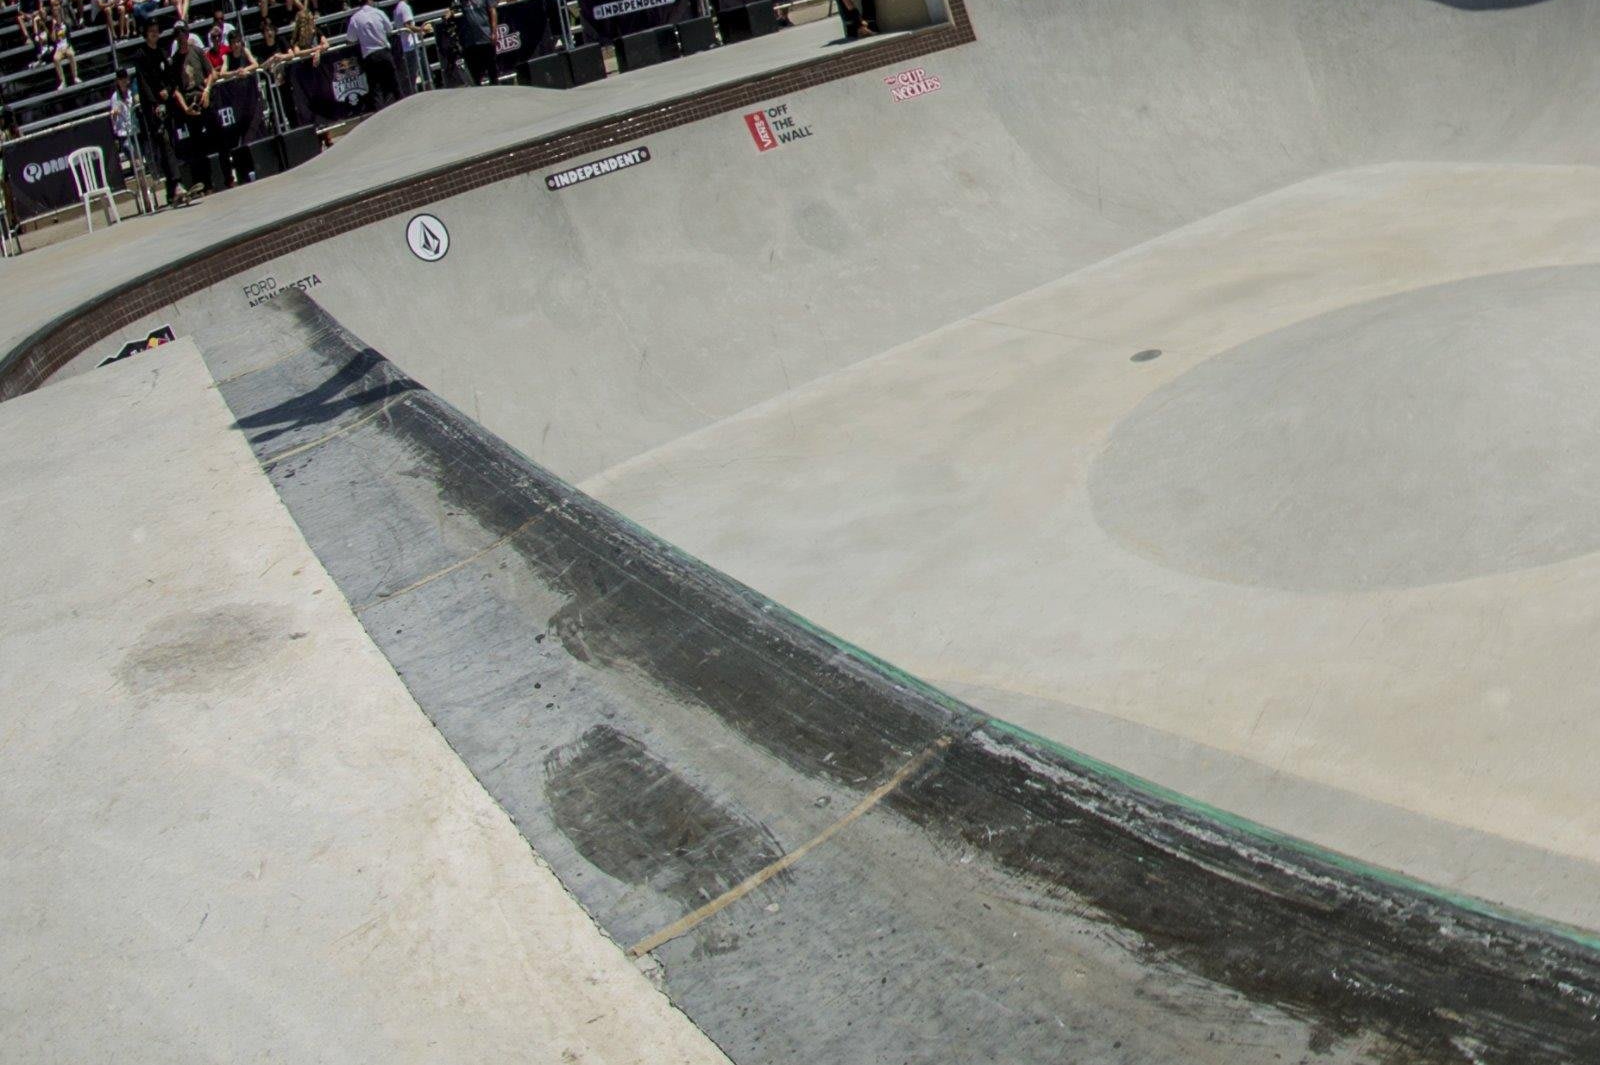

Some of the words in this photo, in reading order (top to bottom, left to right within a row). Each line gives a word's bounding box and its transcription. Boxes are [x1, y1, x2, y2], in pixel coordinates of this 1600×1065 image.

[890, 76, 941, 103] NOODLES
[898, 68, 925, 86] CUP
[754, 118, 772, 149] VANS
[773, 117, 796, 132] THE
[554, 150, 641, 187] INDEPENDENT
[243, 276, 277, 300] FORD
